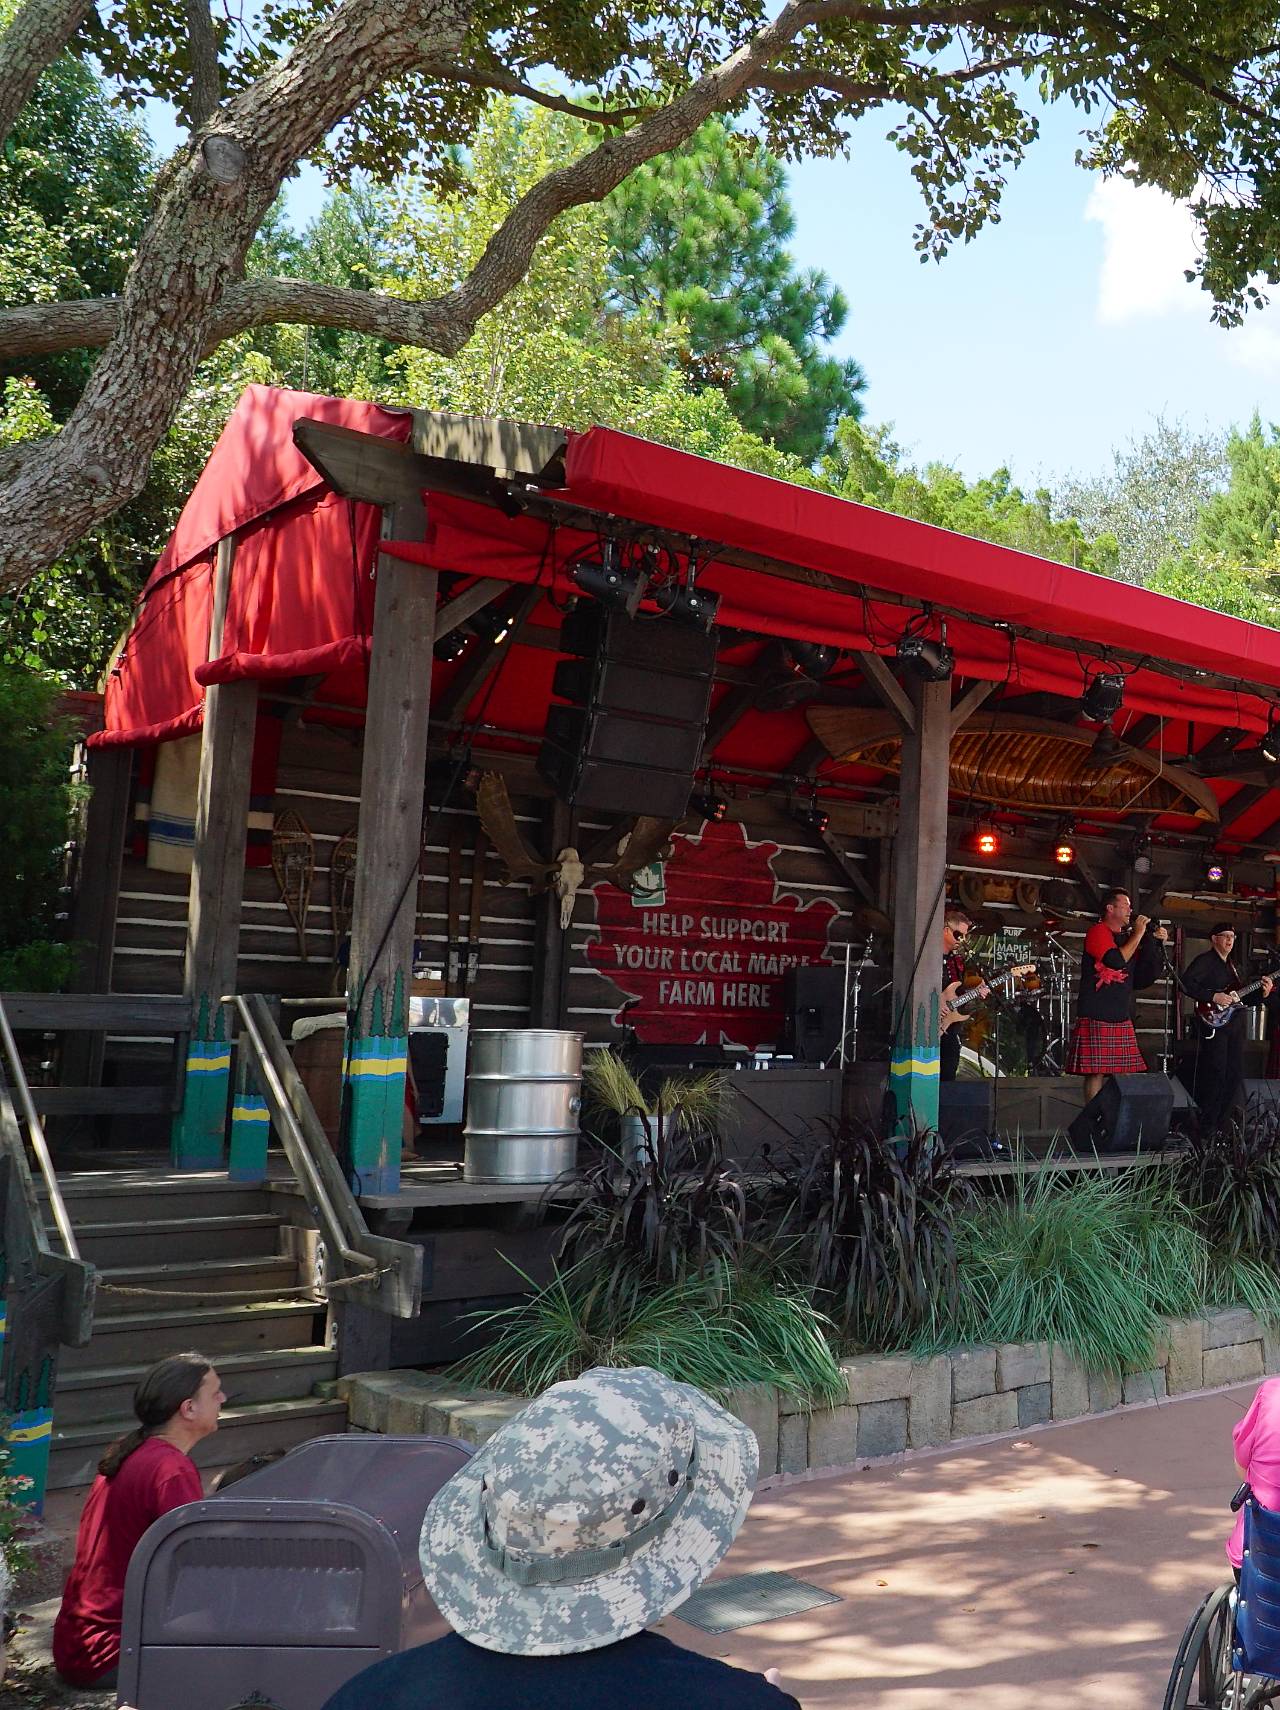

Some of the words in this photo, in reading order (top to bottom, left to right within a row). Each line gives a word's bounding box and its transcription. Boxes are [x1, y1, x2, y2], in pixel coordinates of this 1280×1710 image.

[642, 911, 694, 938] HELP
[700, 915, 790, 944] SUPPORT
[613, 943, 675, 971] YOUR
[681, 947, 741, 974] LOCAL
[659, 980, 715, 1006] FARM
[722, 982, 770, 1008] HERE
